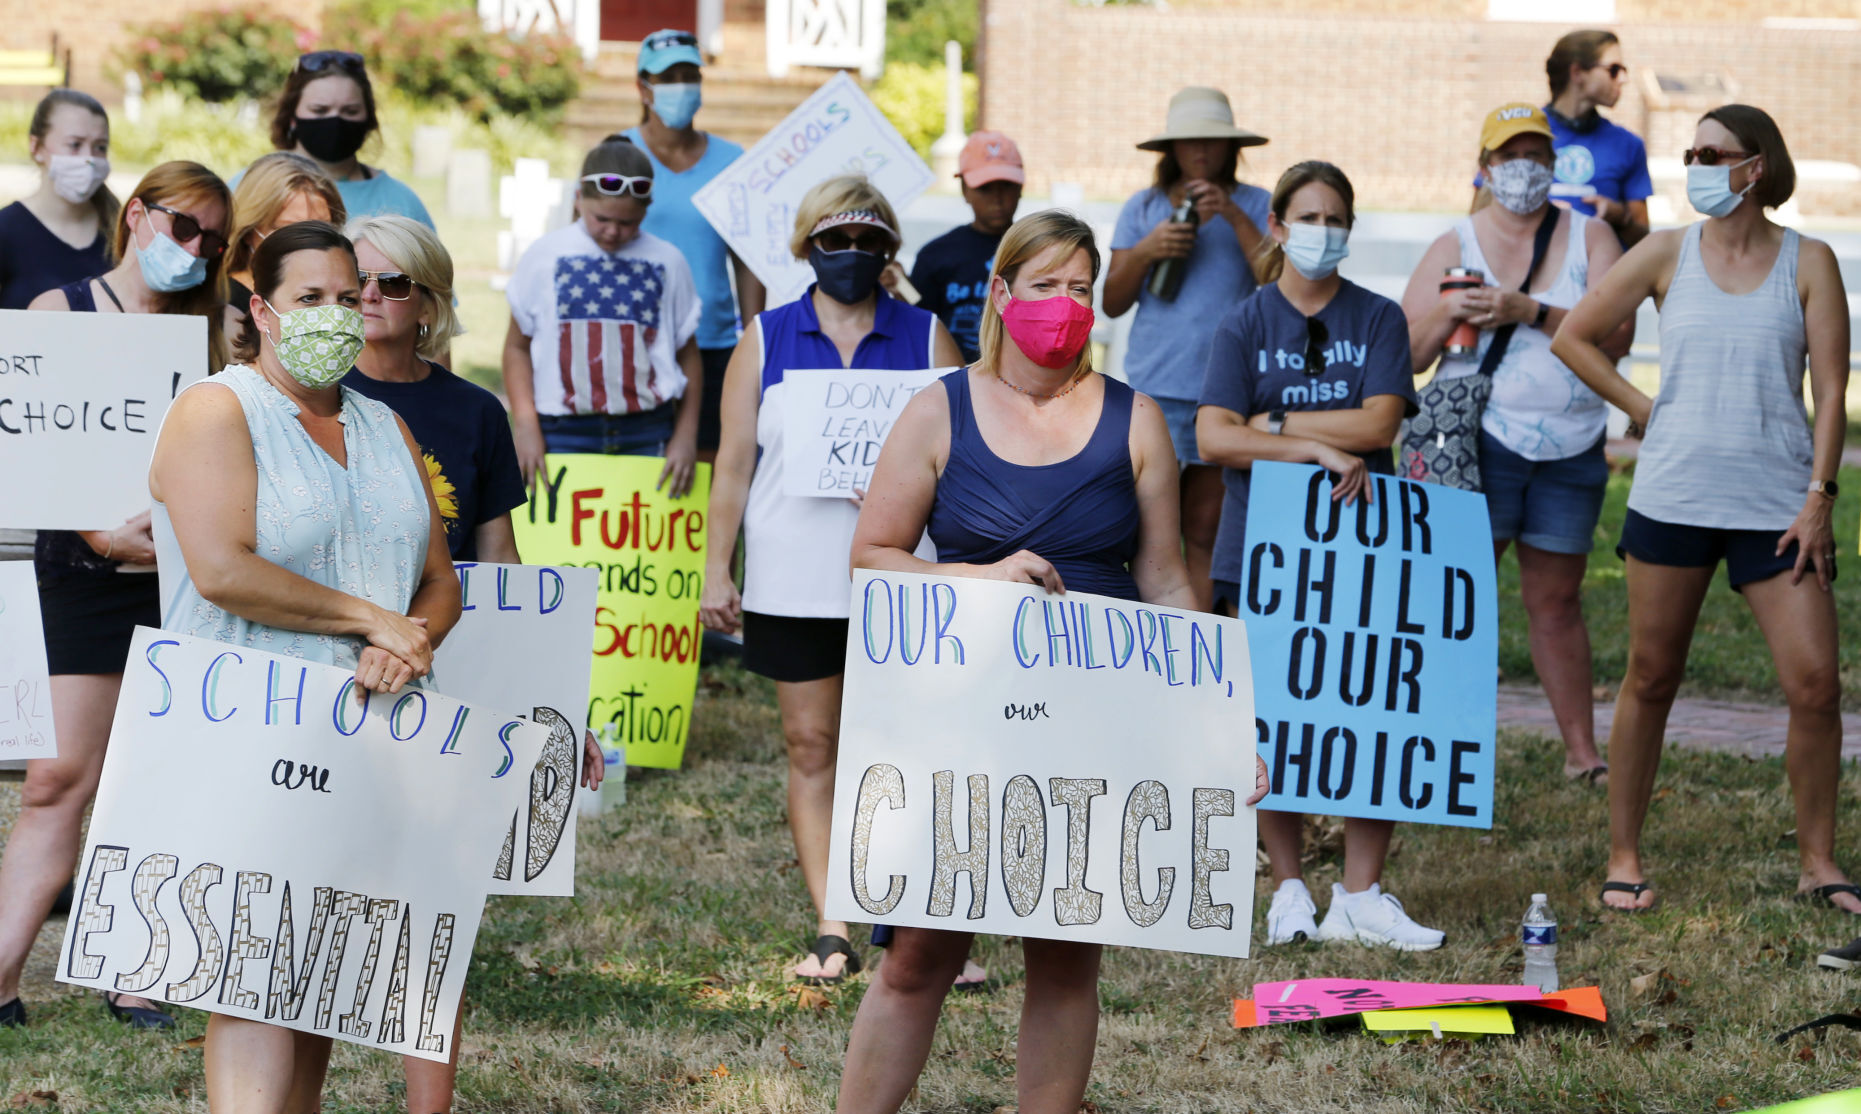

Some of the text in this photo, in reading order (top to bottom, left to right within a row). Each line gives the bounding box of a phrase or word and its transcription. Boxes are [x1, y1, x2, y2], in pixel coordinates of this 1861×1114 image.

[750, 102, 850, 190] SCHOOLS
[1258, 340, 1366, 372] I toally
[1282, 378, 1349, 405] miss
[571, 488, 703, 551] Future
[1304, 469, 1432, 555] OUR
[455, 563, 563, 614] ILD
[667, 569, 702, 600] on
[1246, 541, 1475, 641] CHILD
[593, 607, 700, 664] School
[863, 578, 1233, 698] OUR CHILDREN,
[1287, 626, 1424, 714] OUR
[145, 640, 526, 779] SCHOOLS
[1004, 702, 1050, 721] our
[271, 758, 331, 793] are
[850, 763, 1235, 931] CHOICE
[67, 845, 456, 1053] ESSENTIAL
